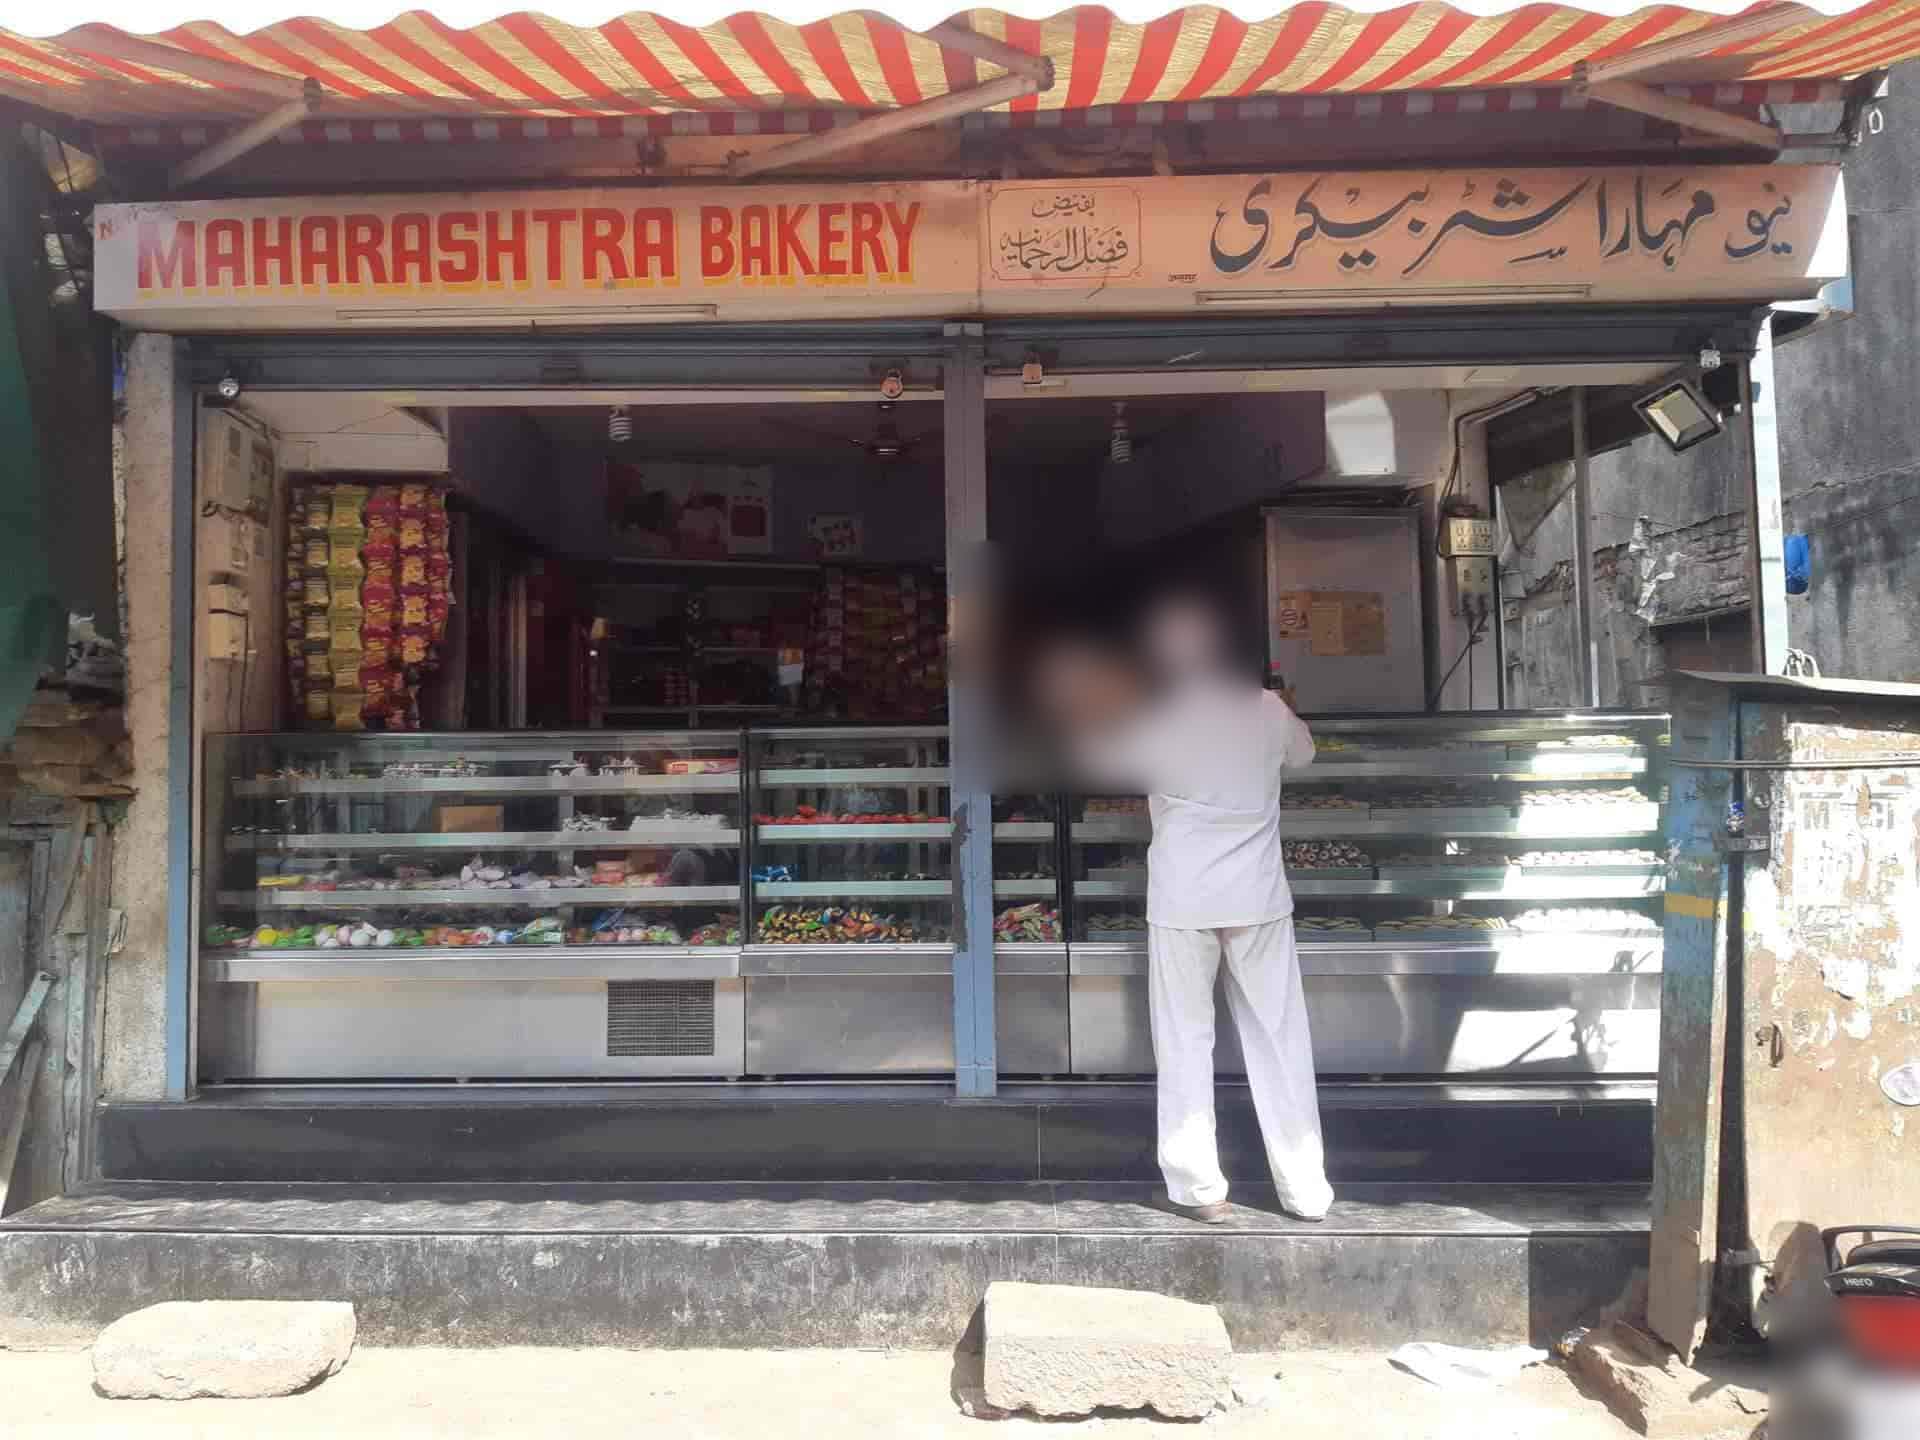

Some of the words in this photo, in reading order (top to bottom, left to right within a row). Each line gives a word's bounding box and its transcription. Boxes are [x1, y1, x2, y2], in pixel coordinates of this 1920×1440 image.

[137, 206, 675, 289] MAHARASHTRA
[700, 201, 920, 277] BAKERY
[1209, 176, 1431, 272] بیکری
